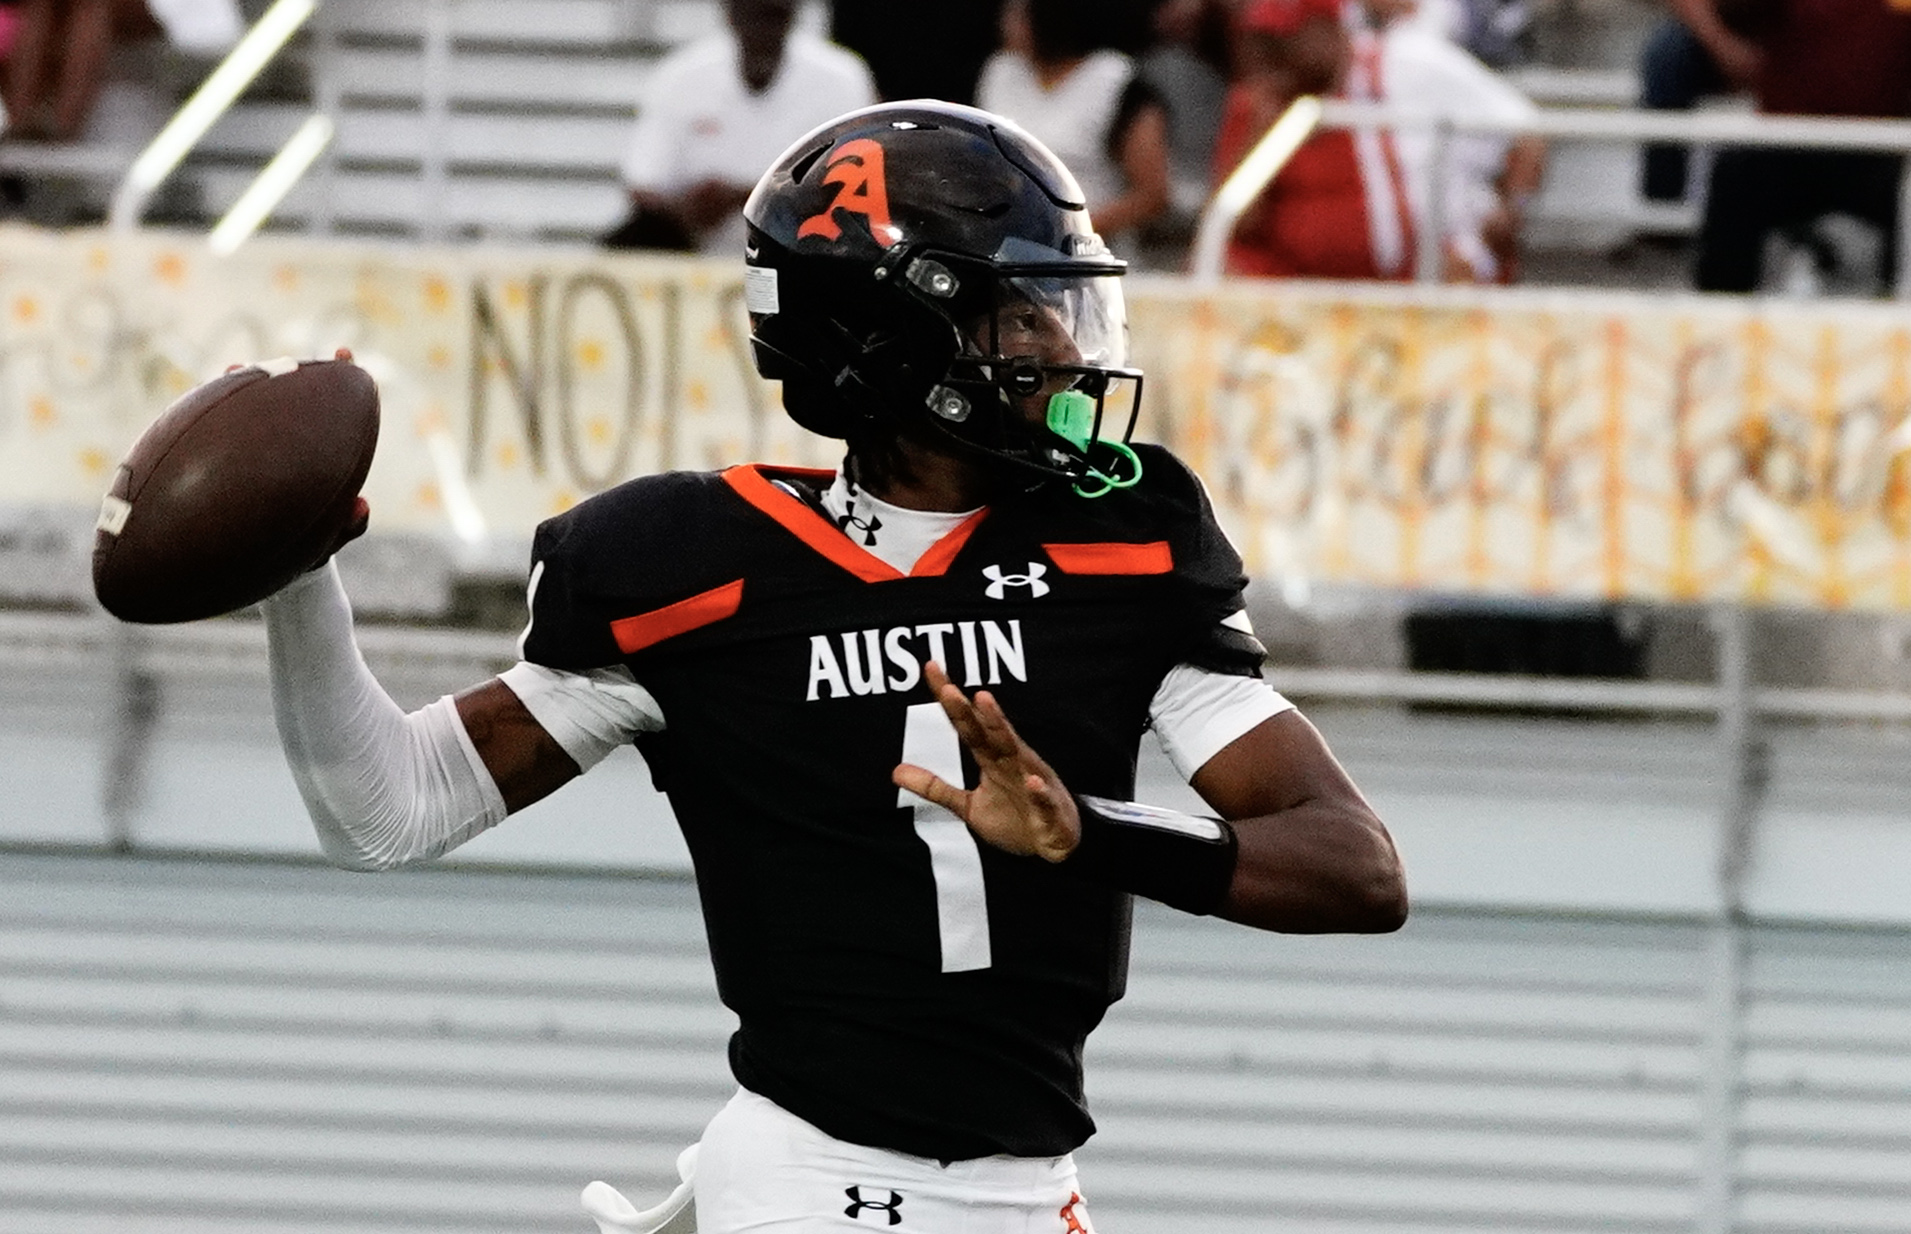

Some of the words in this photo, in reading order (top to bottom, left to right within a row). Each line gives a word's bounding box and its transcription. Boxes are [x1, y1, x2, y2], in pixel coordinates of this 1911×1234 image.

[797, 138, 904, 249] A
[806, 619, 1028, 701] AUSTIN
[896, 702, 992, 973] 1
